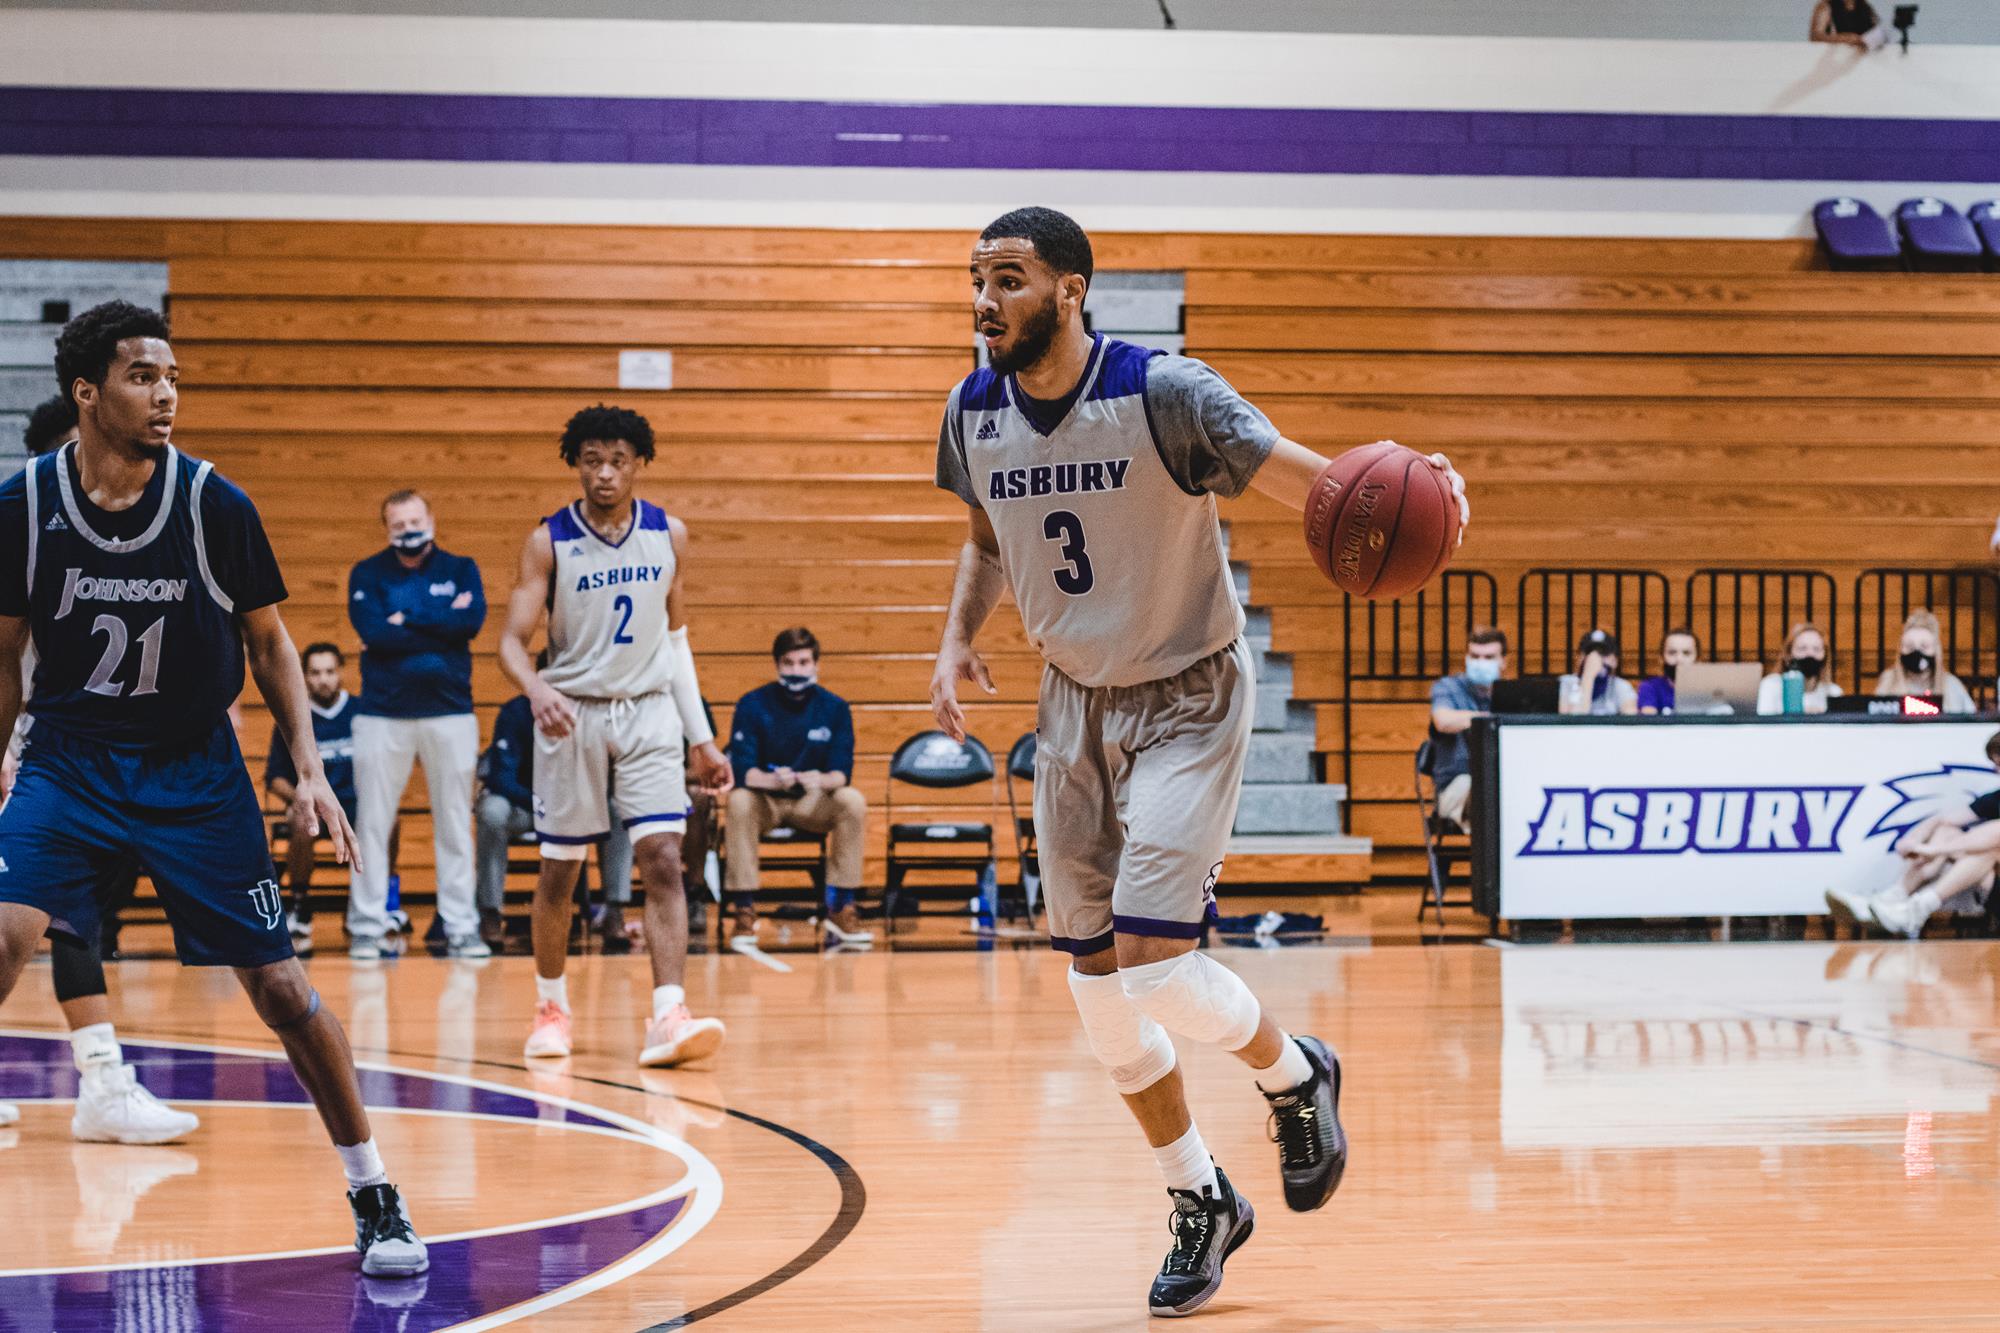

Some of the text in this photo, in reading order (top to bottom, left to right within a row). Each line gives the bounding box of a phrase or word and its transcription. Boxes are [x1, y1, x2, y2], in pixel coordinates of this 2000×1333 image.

[989, 458, 1133, 501] ASBURY
[1042, 508, 1094, 596] 3
[1337, 479, 1388, 582] SPALDING
[576, 566, 662, 592] ASBURY
[613, 594, 633, 644] 2
[83, 613, 165, 697] 21
[1517, 786, 1863, 855] ASBURY
